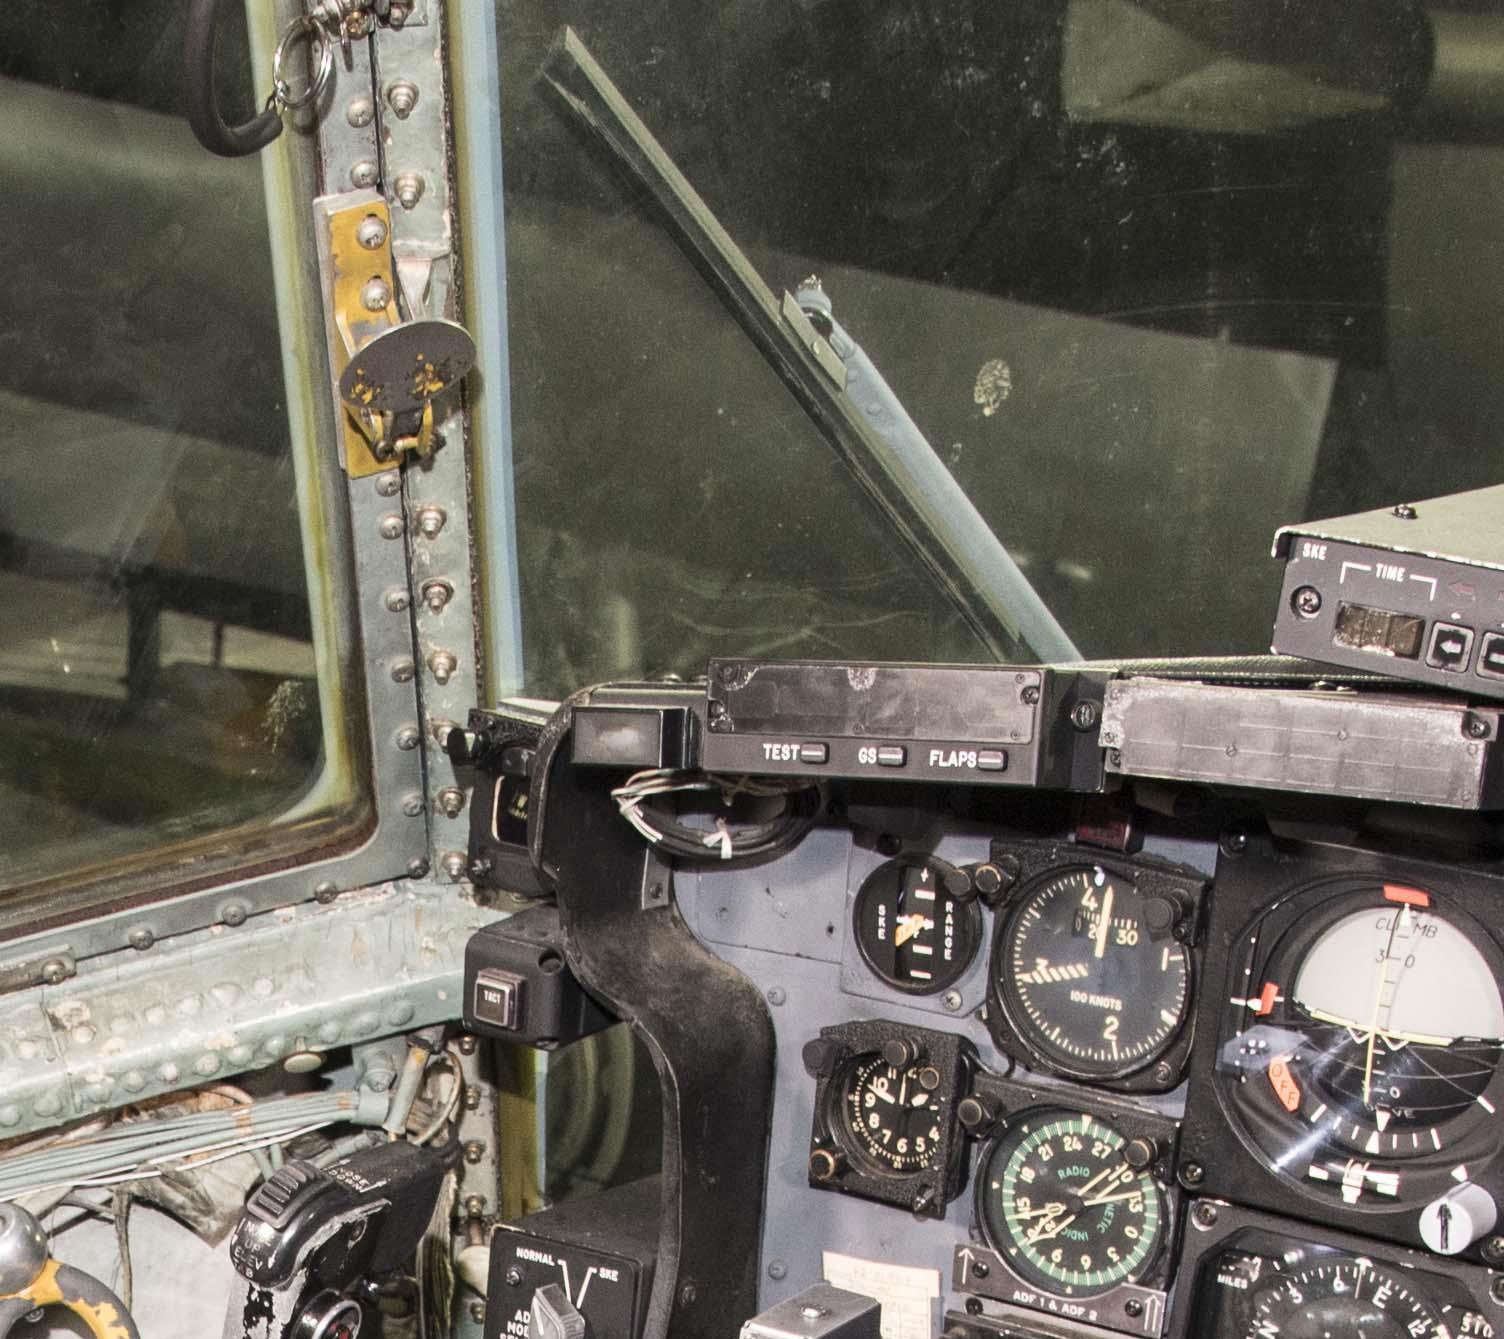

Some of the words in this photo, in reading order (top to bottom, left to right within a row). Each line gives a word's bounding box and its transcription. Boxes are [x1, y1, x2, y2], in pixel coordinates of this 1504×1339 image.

[1303, 544, 1326, 560] SKE
[1375, 564, 1405, 581] TIME
[763, 743, 799, 762] TEST
[858, 747, 876, 764] GS
[929, 750, 977, 770] FLAPS
[1058, 1167, 1090, 1179] RADIO
[517, 1248, 555, 1267] NORMAL
[599, 1268, 618, 1282] SKE
[1217, 1274, 1248, 1289] MILES
